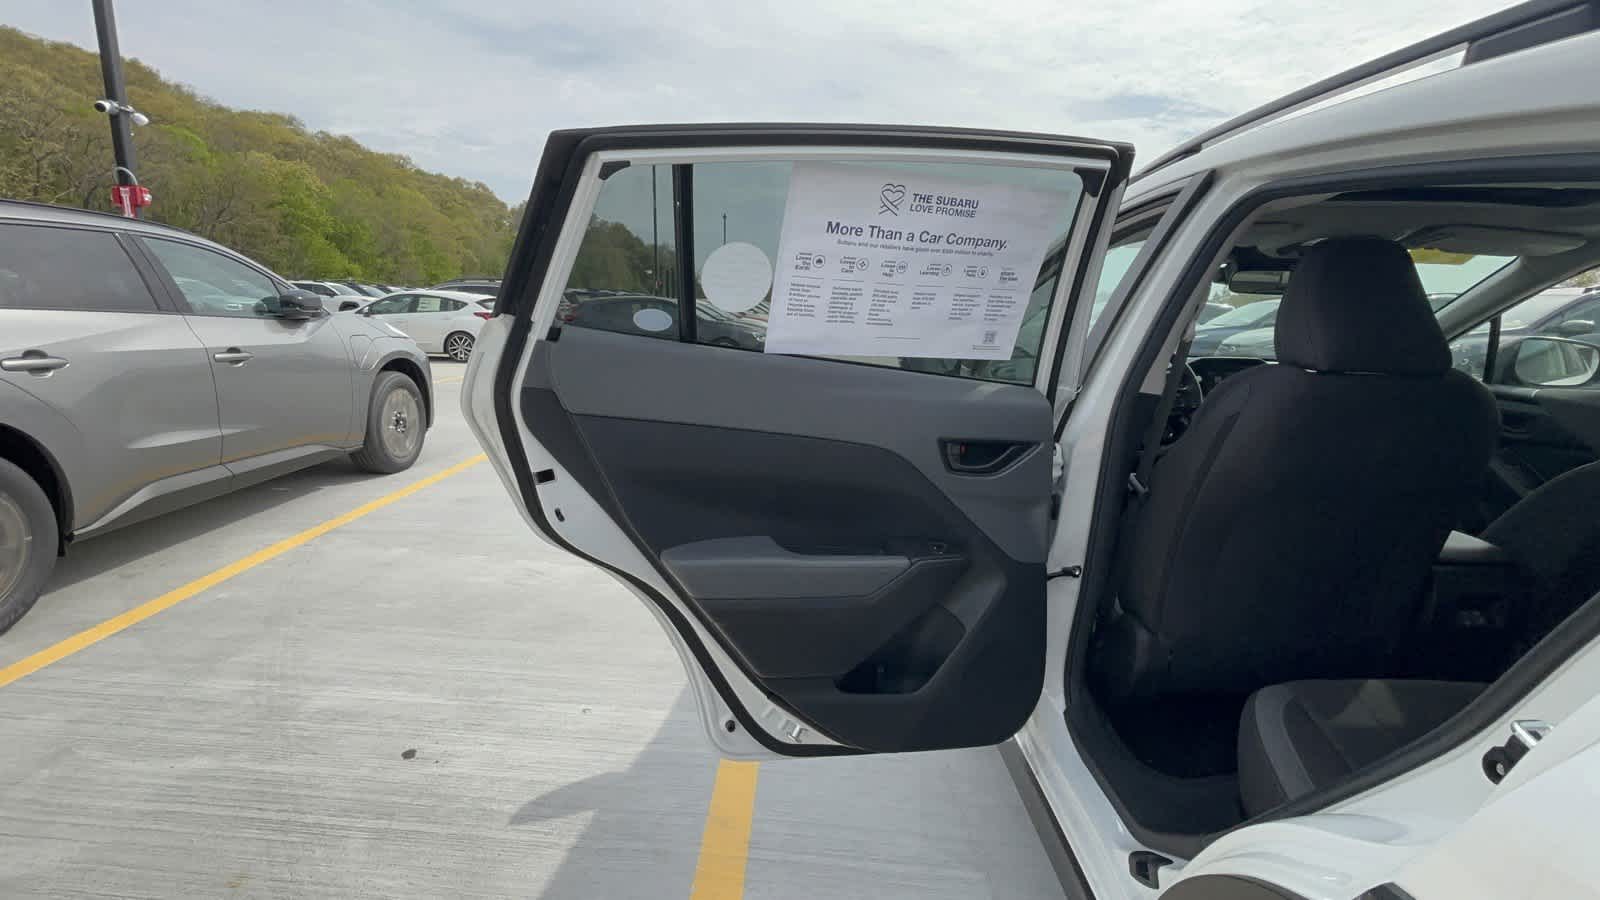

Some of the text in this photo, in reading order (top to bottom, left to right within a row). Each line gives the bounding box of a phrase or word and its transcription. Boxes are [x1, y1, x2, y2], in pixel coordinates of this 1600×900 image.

[912, 193, 979, 209] THE SUBARU
[909, 203, 976, 218] LOVE PROMISE
[826, 221, 1008, 250] More Than a Car Company.
